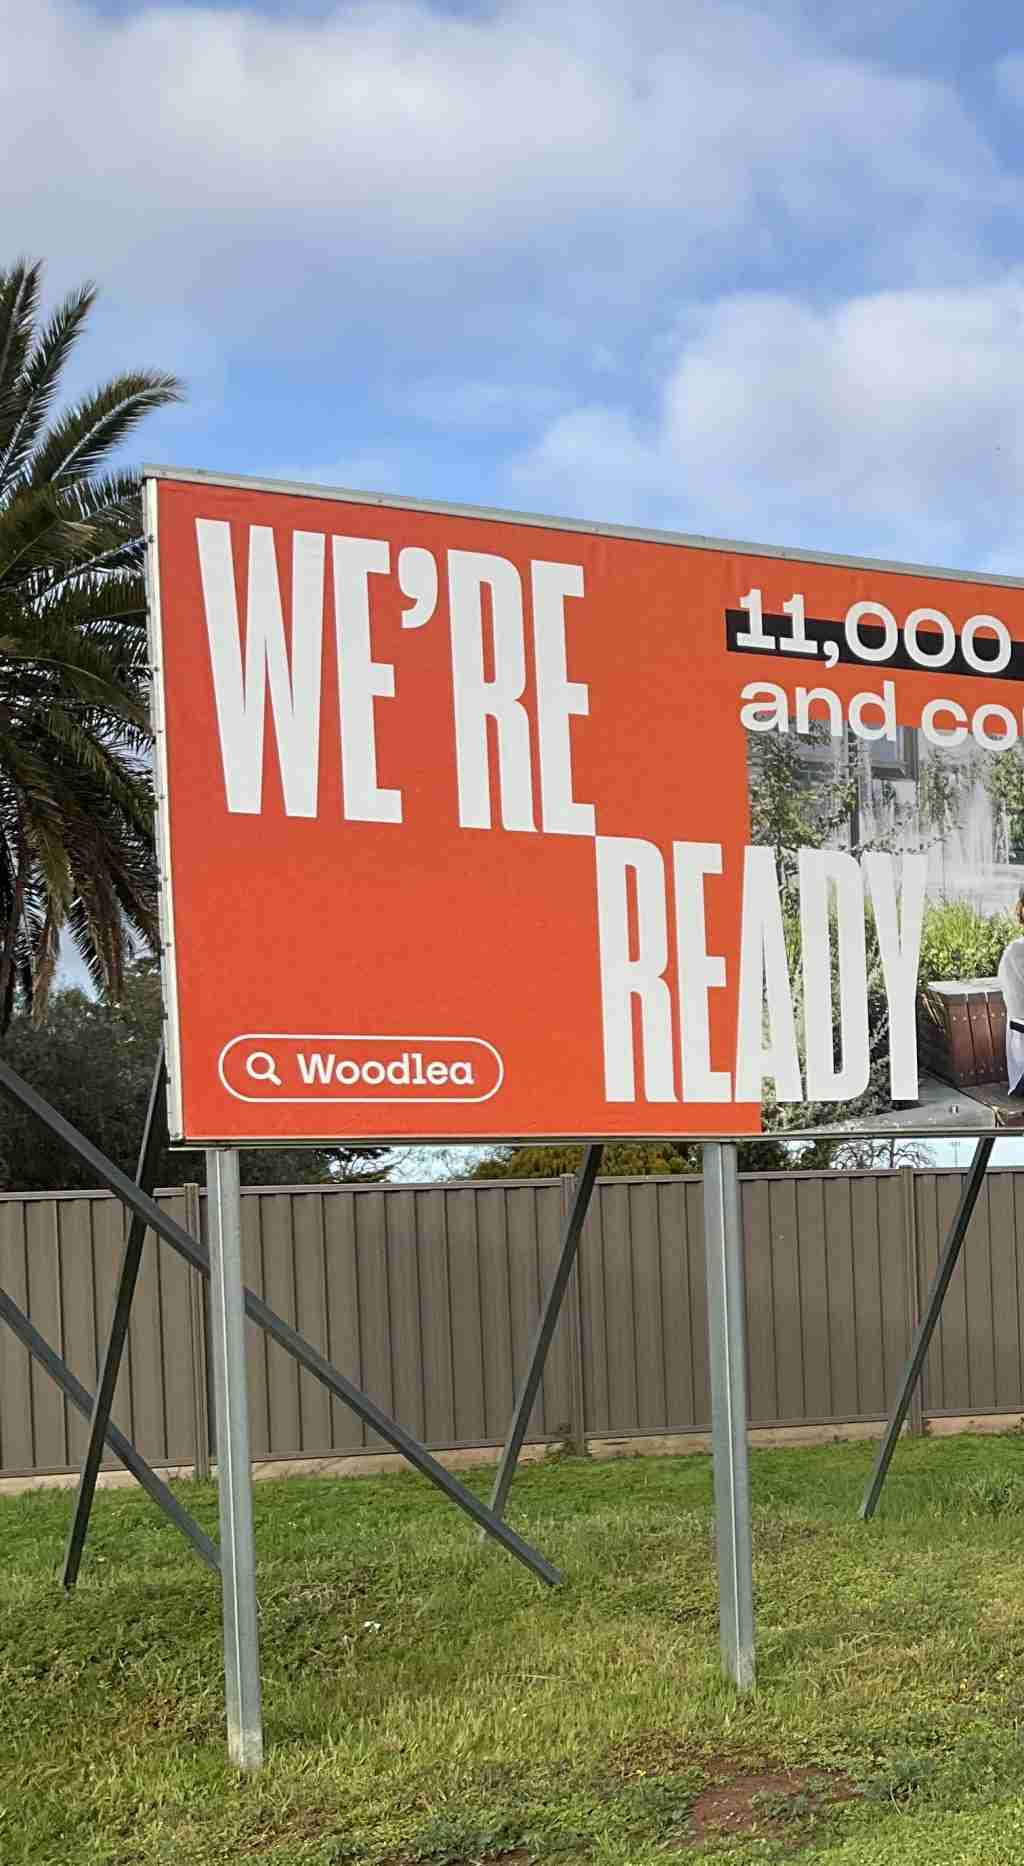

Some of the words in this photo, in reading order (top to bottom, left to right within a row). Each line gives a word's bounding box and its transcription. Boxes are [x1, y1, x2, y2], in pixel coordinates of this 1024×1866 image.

[735, 588, 1013, 669] 11,000
[739, 680, 897, 743] and
[595, 836, 929, 1104] READY
[296, 1052, 475, 1085] Woodlea
